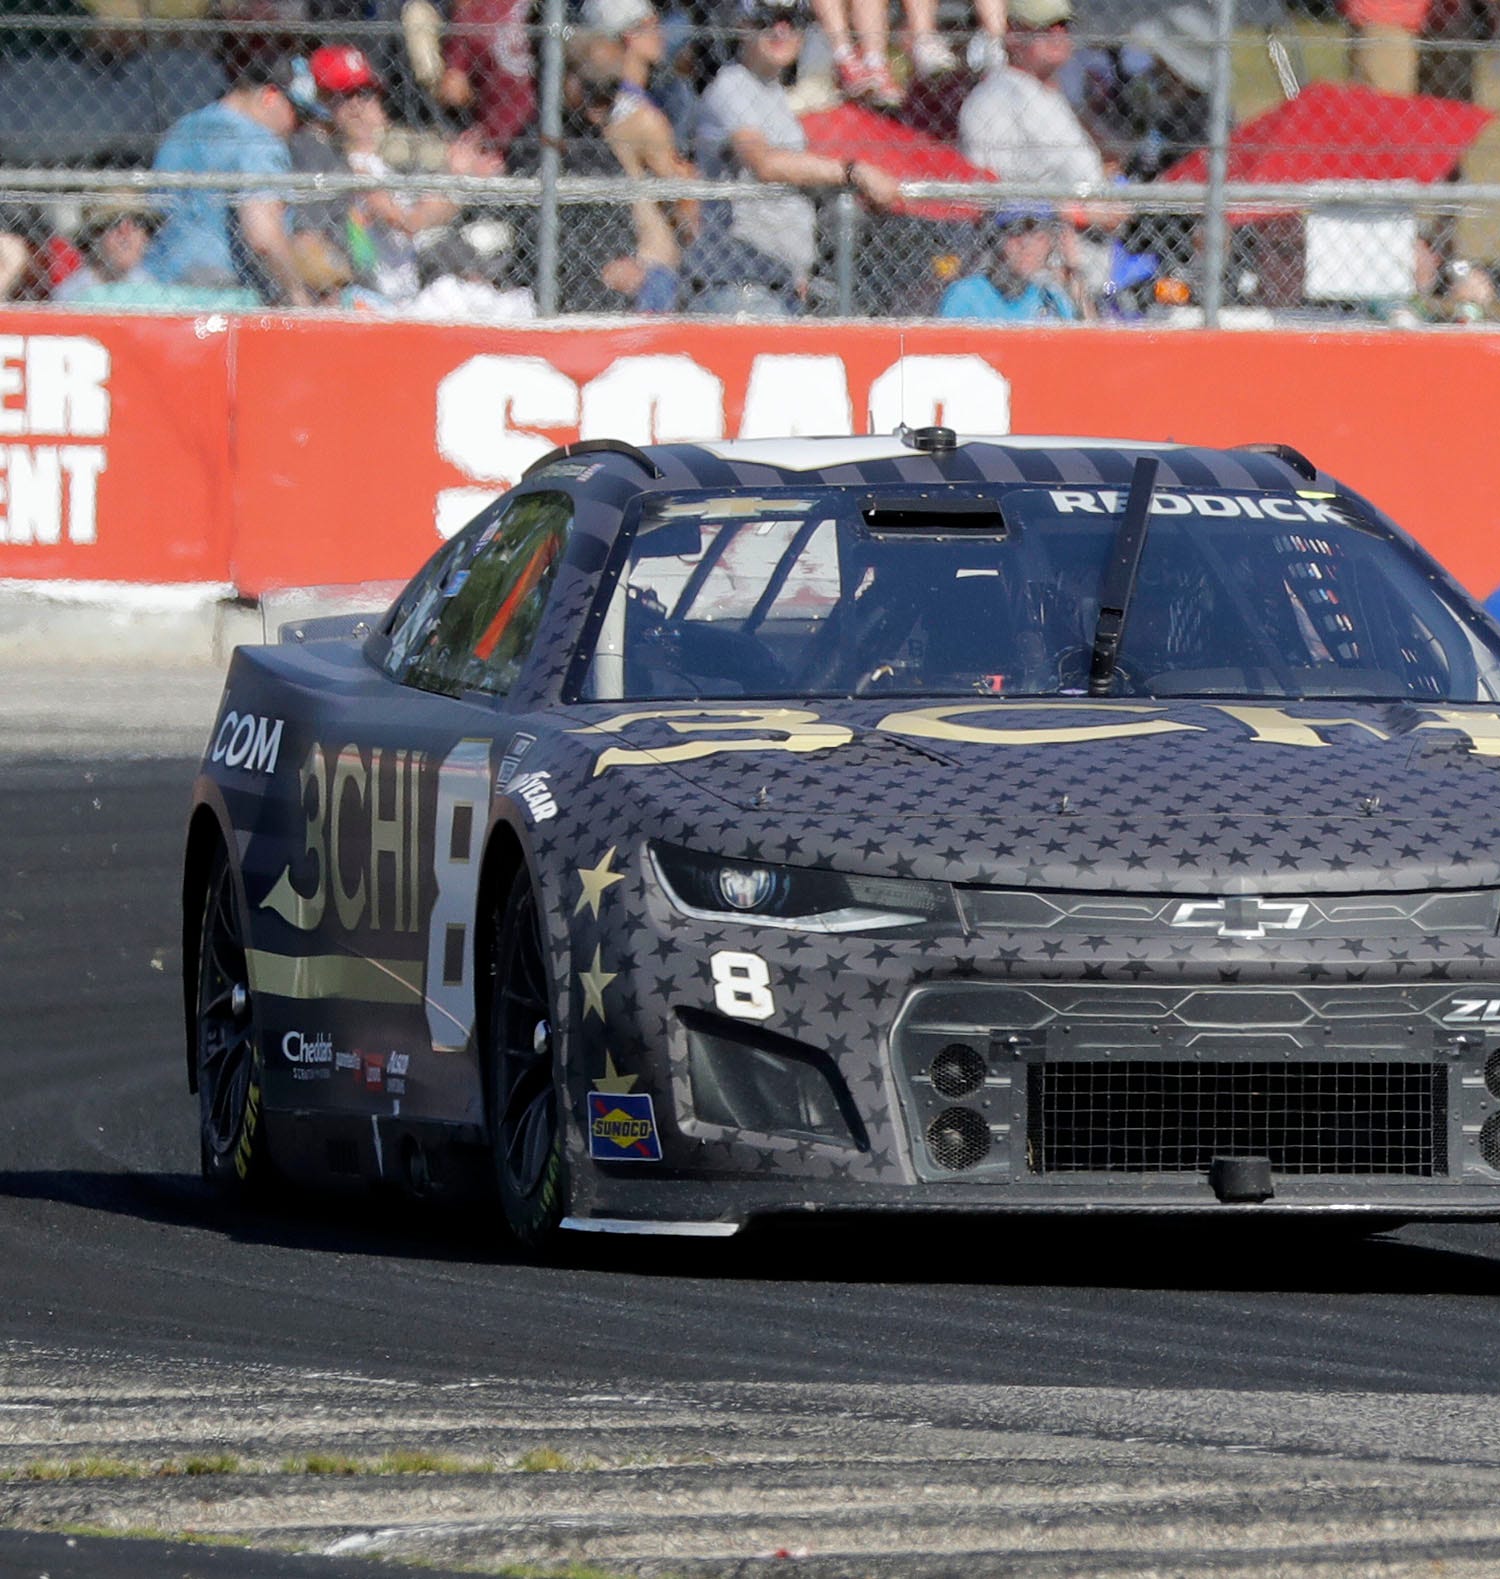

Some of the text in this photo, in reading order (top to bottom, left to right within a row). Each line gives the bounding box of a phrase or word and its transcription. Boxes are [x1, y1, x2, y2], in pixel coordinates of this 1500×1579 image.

[0, 444, 108, 545] NT
[259, 742, 420, 933] 3CHI
[426, 738, 493, 1052] 8
[710, 950, 776, 1020] 8
[594, 1120, 650, 1138] SUNOCO
